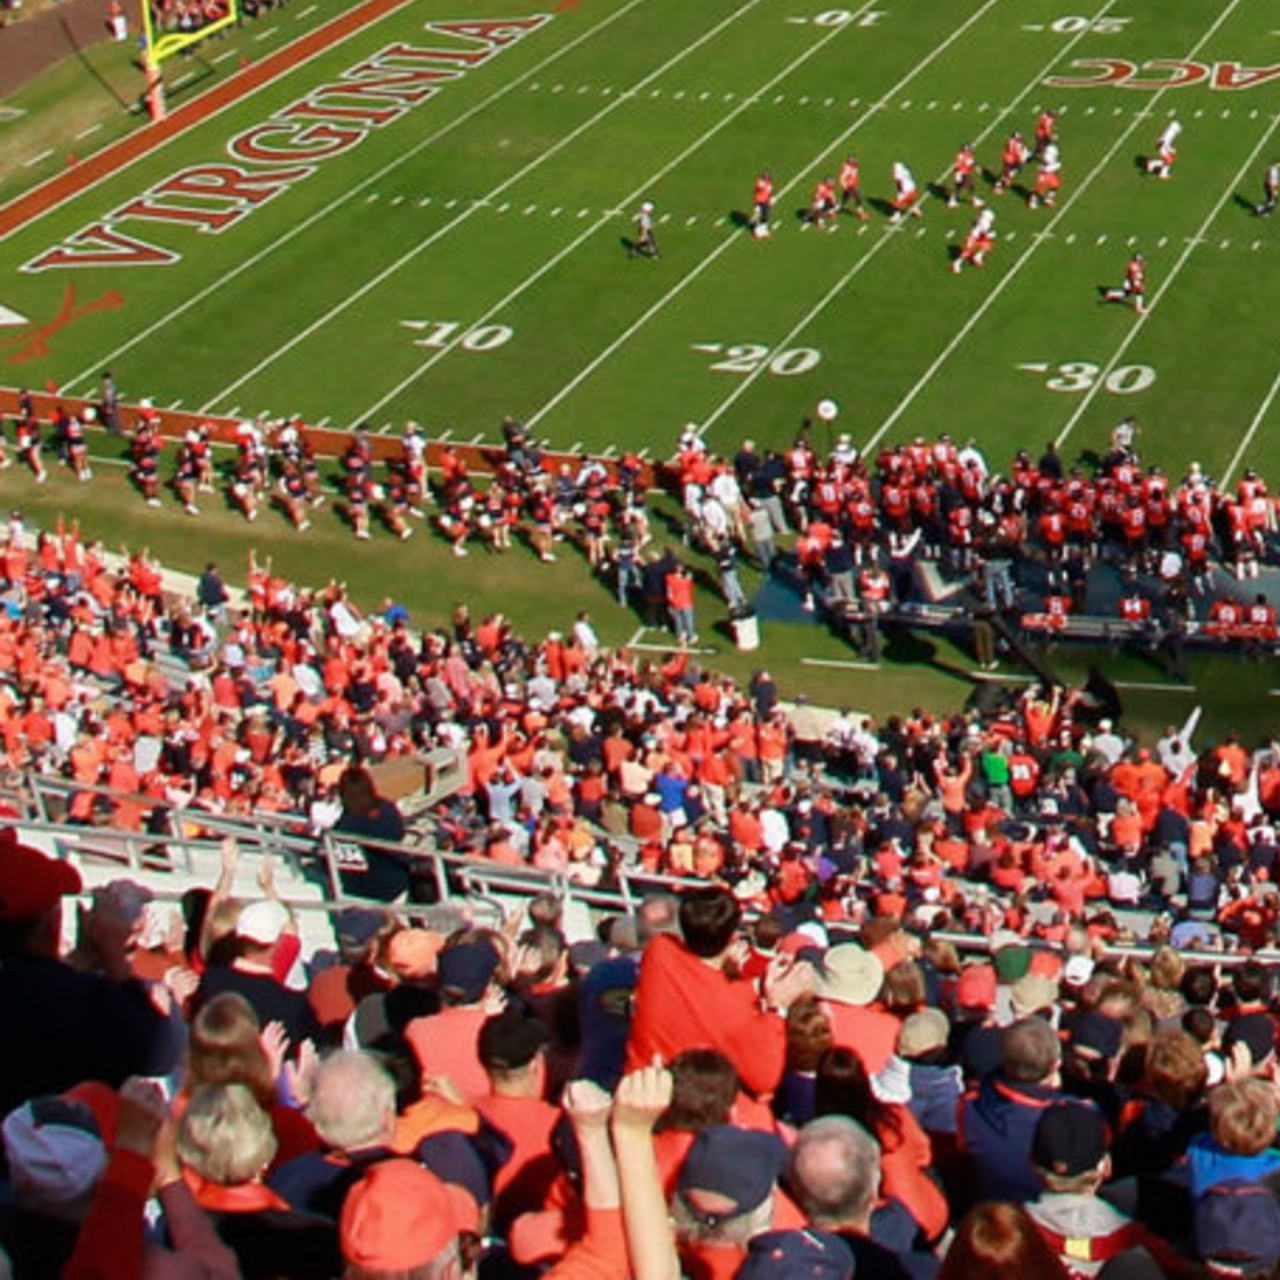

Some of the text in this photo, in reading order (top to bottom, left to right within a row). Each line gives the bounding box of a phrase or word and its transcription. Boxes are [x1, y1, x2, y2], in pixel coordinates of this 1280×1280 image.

[813, 10, 886, 26] 10
[1051, 16, 1132, 35] 20
[19, 14, 553, 271] VIRGINIA
[414, 323, 513, 351] 10
[711, 346, 821, 376] 20
[1046, 363, 1157, 394] 30
